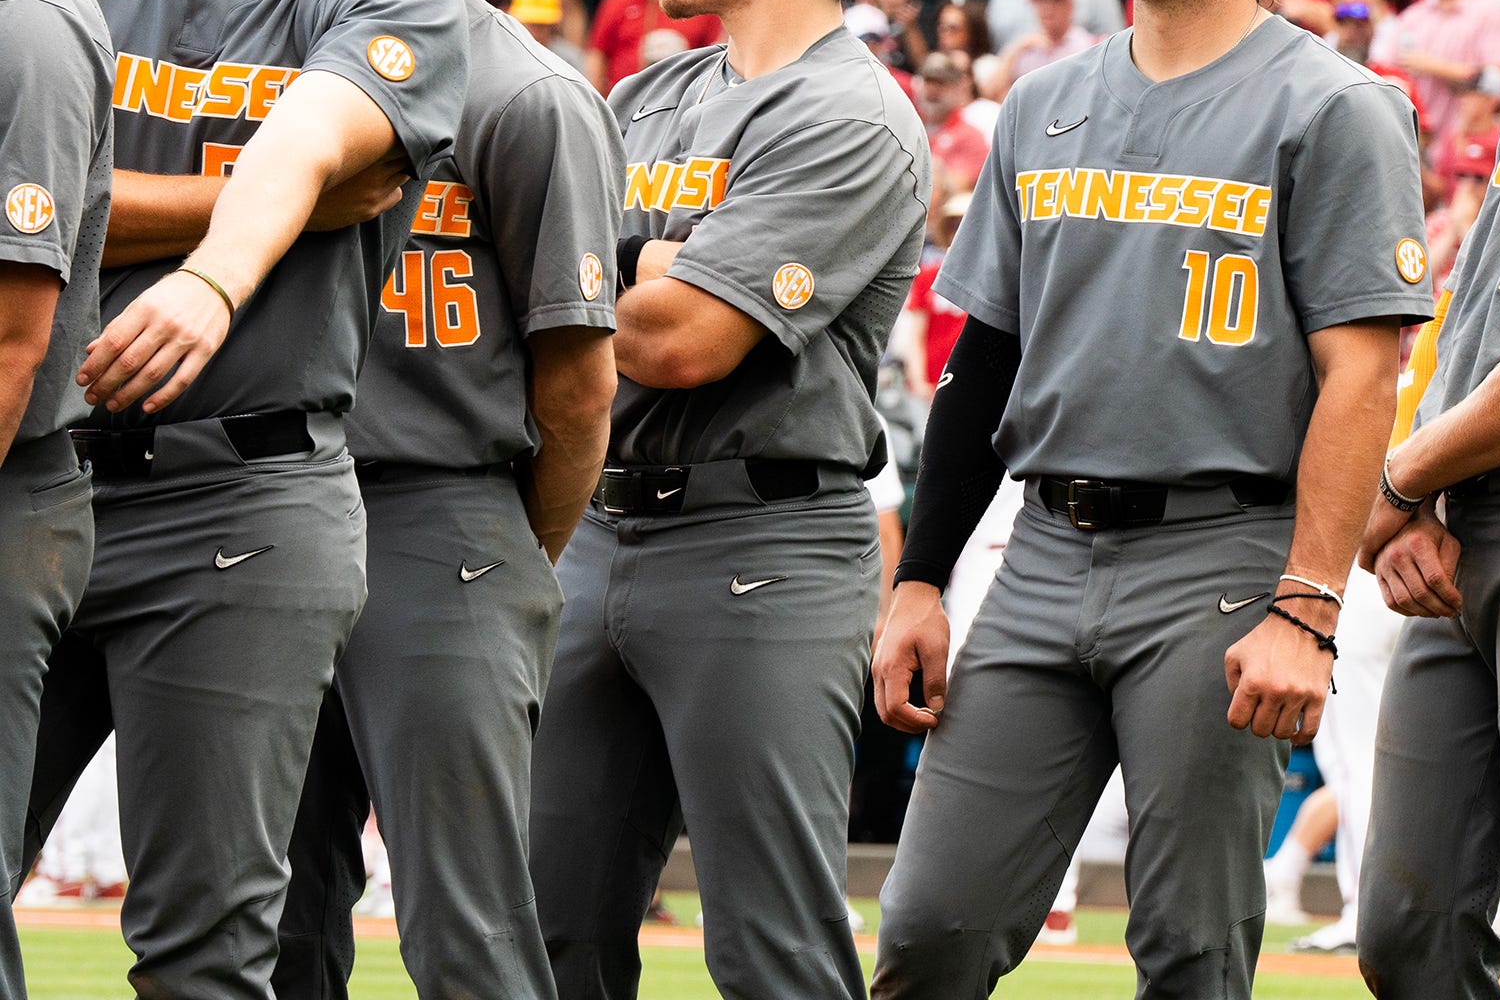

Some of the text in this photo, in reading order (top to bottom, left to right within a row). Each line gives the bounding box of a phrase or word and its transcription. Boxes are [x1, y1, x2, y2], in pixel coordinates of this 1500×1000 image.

[371, 39, 412, 78] SEC
[9, 188, 51, 230] SEC
[1015, 167, 1272, 237] TENNESSEE
[580, 260, 600, 297] SEC
[1398, 242, 1425, 280] SEC
[380, 249, 482, 347] 46
[774, 268, 810, 305] SEC
[1178, 250, 1259, 346] 10
